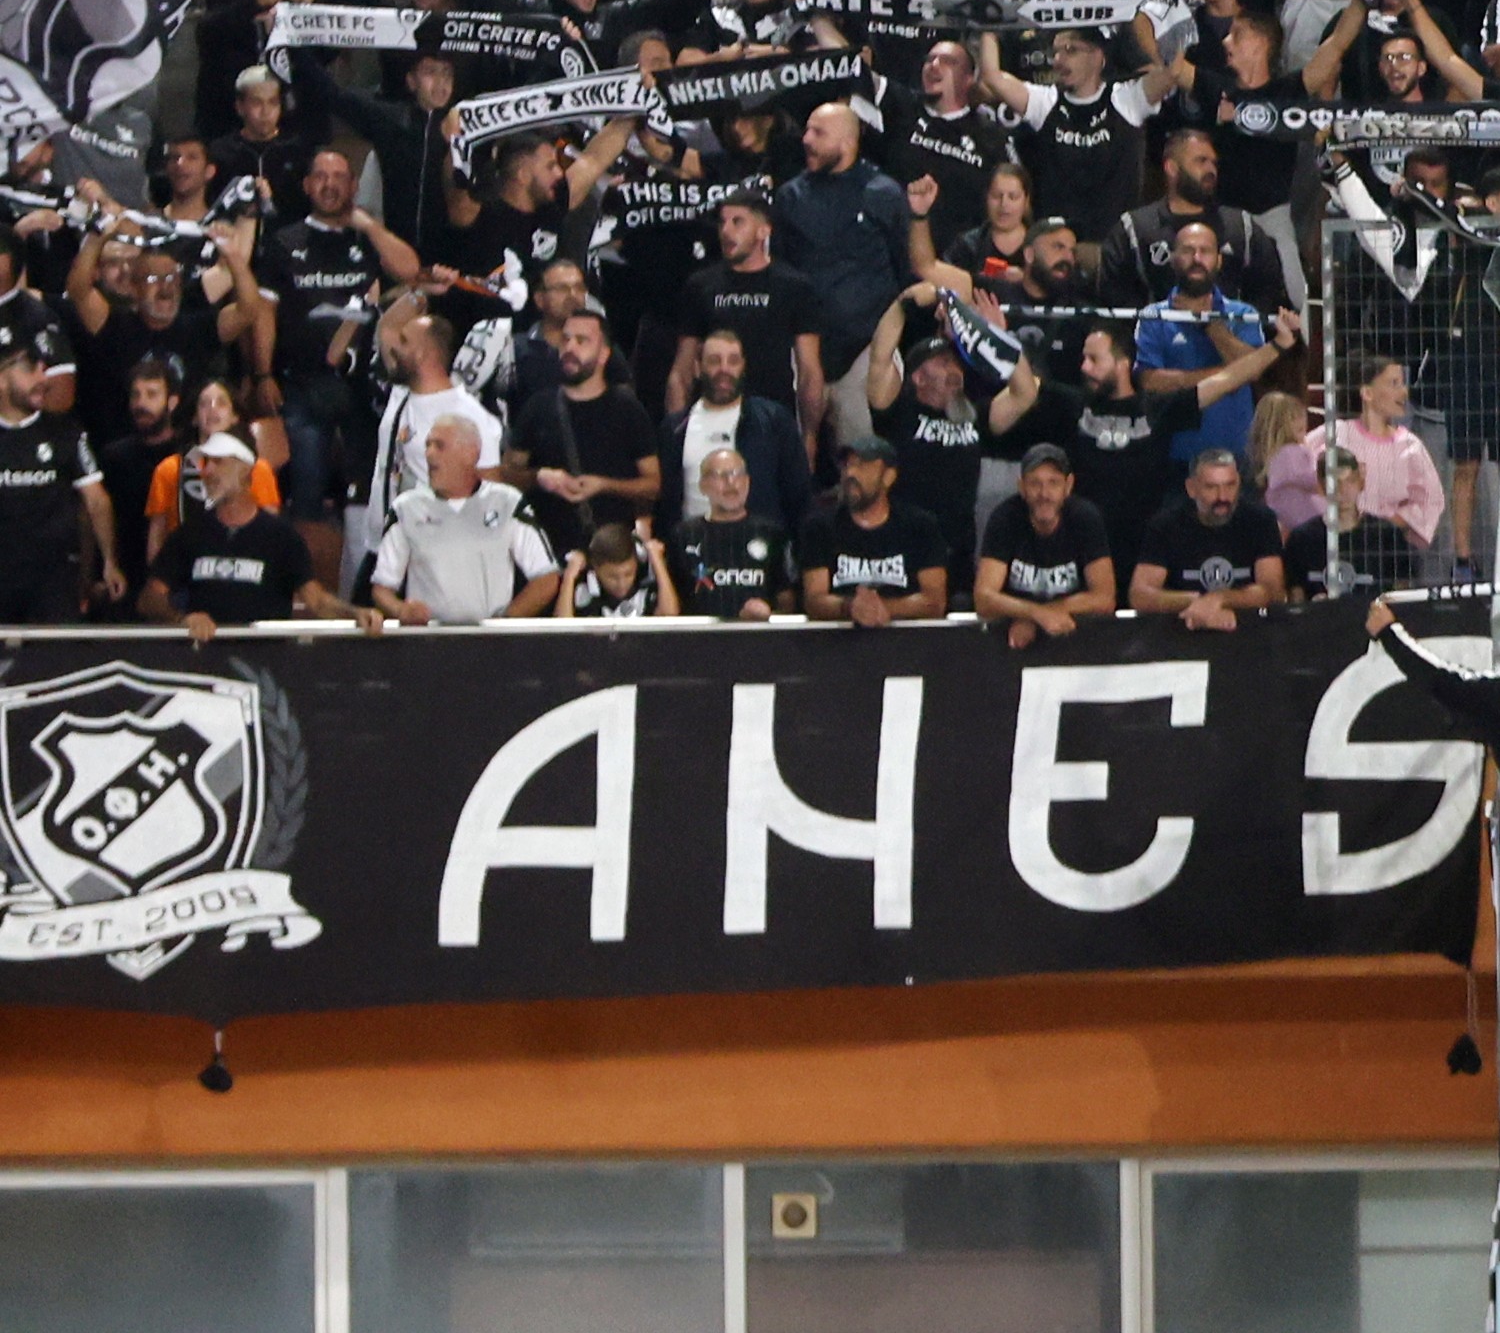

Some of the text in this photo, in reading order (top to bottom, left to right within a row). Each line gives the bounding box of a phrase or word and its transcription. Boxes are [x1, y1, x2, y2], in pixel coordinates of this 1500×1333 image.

[1032, 4, 1115, 24] CLUB
[443, 22, 561, 49] OFI CRETE FC
[568, 78, 628, 109] SINCE
[667, 55, 863, 108] ΝΗΣΙ ΜΙΑ ΟΜΑΔΑ
[909, 131, 984, 167] betsson
[617, 181, 705, 205] THIS IS
